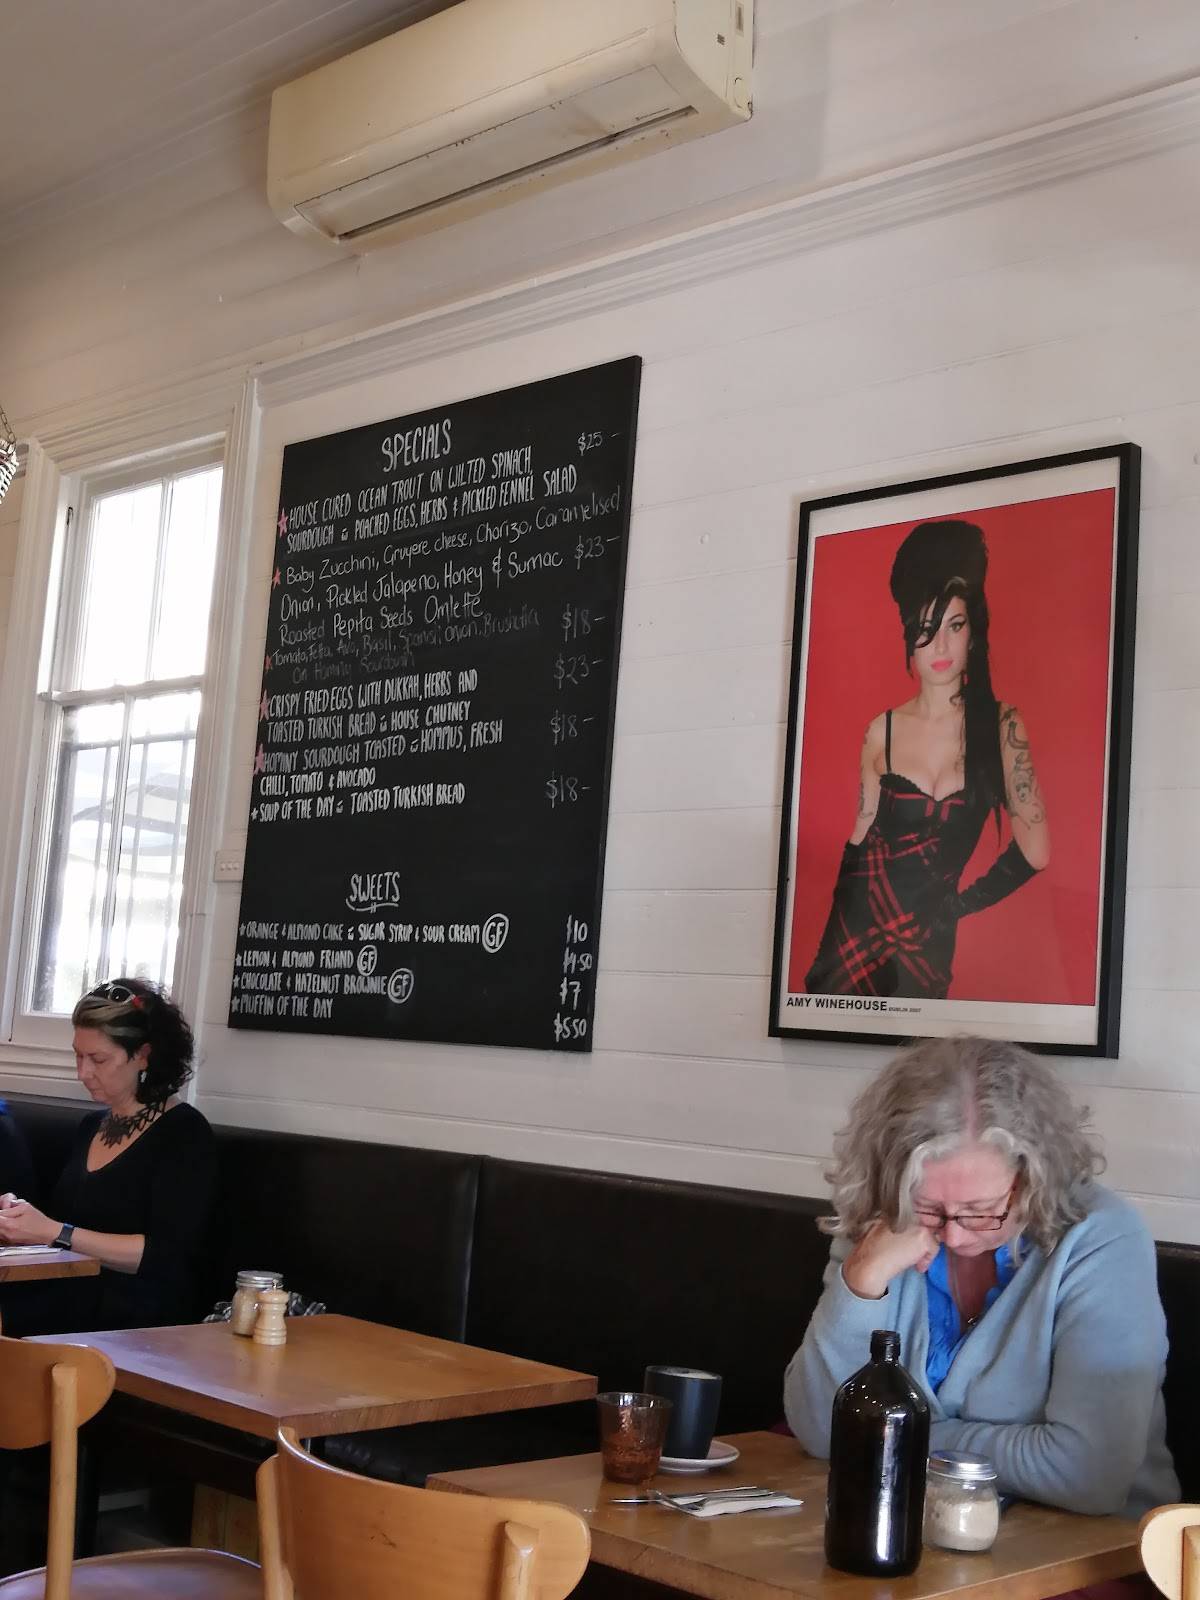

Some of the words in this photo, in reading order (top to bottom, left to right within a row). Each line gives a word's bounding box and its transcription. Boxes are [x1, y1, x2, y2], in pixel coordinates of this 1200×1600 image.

[381, 418, 451, 472] SPECIALS
[287, 524, 334, 554] SOURDOUGH
[354, 512, 390, 541] POACHED
[421, 495, 448, 525] HERBS
[461, 485, 497, 517] PICKLED
[499, 475, 535, 507] FENNEL
[543, 464, 577, 497] SALAD
[289, 500, 319, 529] HOUSE
[322, 492, 351, 522] CURED
[358, 484, 388, 512] OCEAN
[392, 473, 424, 504] TROUT
[430, 468, 443, 493] ON
[448, 457, 486, 489] WILTED
[286, 565, 314, 593] Baby
[319, 554, 380, 580] Zucchini,
[384, 539, 431, 568] Gruyere
[434, 531, 473, 552] cheese,
[476, 519, 532, 544] Chorizo,
[535, 485, 621, 530] Caramelised
[281, 594, 321, 621] Onion,
[326, 580, 367, 609] Pickled
[373, 572, 440, 602] Jalapeno,
[444, 560, 483, 597] Honey
[508, 551, 563, 579] Sumac
[279, 619, 325, 647] Roasted
[333, 608, 373, 639] Pepita
[380, 604, 413, 629] Seeds
[425, 591, 484, 624] Omlette
[269, 692, 301, 718] CRISPY
[304, 689, 329, 715] FRIED
[330, 685, 354, 711] EGGS
[358, 679, 382, 708] WITH
[384, 673, 422, 705] DUKKAH,
[424, 671, 451, 698] HERBS
[458, 668, 478, 693] AND
[267, 719, 304, 743] TOASTED
[308, 715, 343, 740] TURKISH
[348, 711, 376, 737] BREAD
[391, 709, 419, 731] HOUSE
[425, 700, 471, 726] CHUTNEY
[263, 751, 298, 773] HOMINY
[303, 743, 360, 770] SOURDOUGH
[364, 734, 406, 761] TOASTED
[421, 725, 467, 752] HOMMUS,
[470, 720, 503, 749] FRESH
[260, 774, 289, 797] CHILLI,
[290, 771, 323, 794] TOMATO
[336, 767, 376, 789] AVOCADO
[260, 802, 280, 822] SOUP
[281, 800, 293, 820] OF
[295, 798, 312, 819] THE
[316, 795, 335, 818] DAY
[351, 788, 390, 815] TOASTED
[392, 783, 434, 809] TURKISH
[436, 782, 465, 805] BREAD
[350, 872, 400, 902] SWEETS
[246, 921, 280, 940] ORANGE
[287, 923, 320, 941] ALMOND
[322, 923, 344, 941] CAKE
[358, 921, 386, 941] SUGAR
[388, 924, 414, 942] SYRUP
[423, 925, 445, 943] SOUR
[449, 924, 480, 944] CREAM
[566, 914, 588, 944] $10
[243, 951, 270, 968] LEMON
[282, 950, 315, 968] ALMOND
[320, 950, 354, 969] FRIAND
[240, 972, 283, 991] CHOCOLATE
[295, 973, 341, 994] HAZELNUT
[343, 974, 387, 995] BROWNIE
[559, 976, 582, 1010] $7
[240, 994, 274, 1015] MUFFIN
[277, 995, 290, 1016] OF
[291, 995, 308, 1017] THE
[313, 998, 334, 1019] DAY
[786, 997, 812, 1008] AMY
[815, 998, 888, 1011] WINEHOUSE
